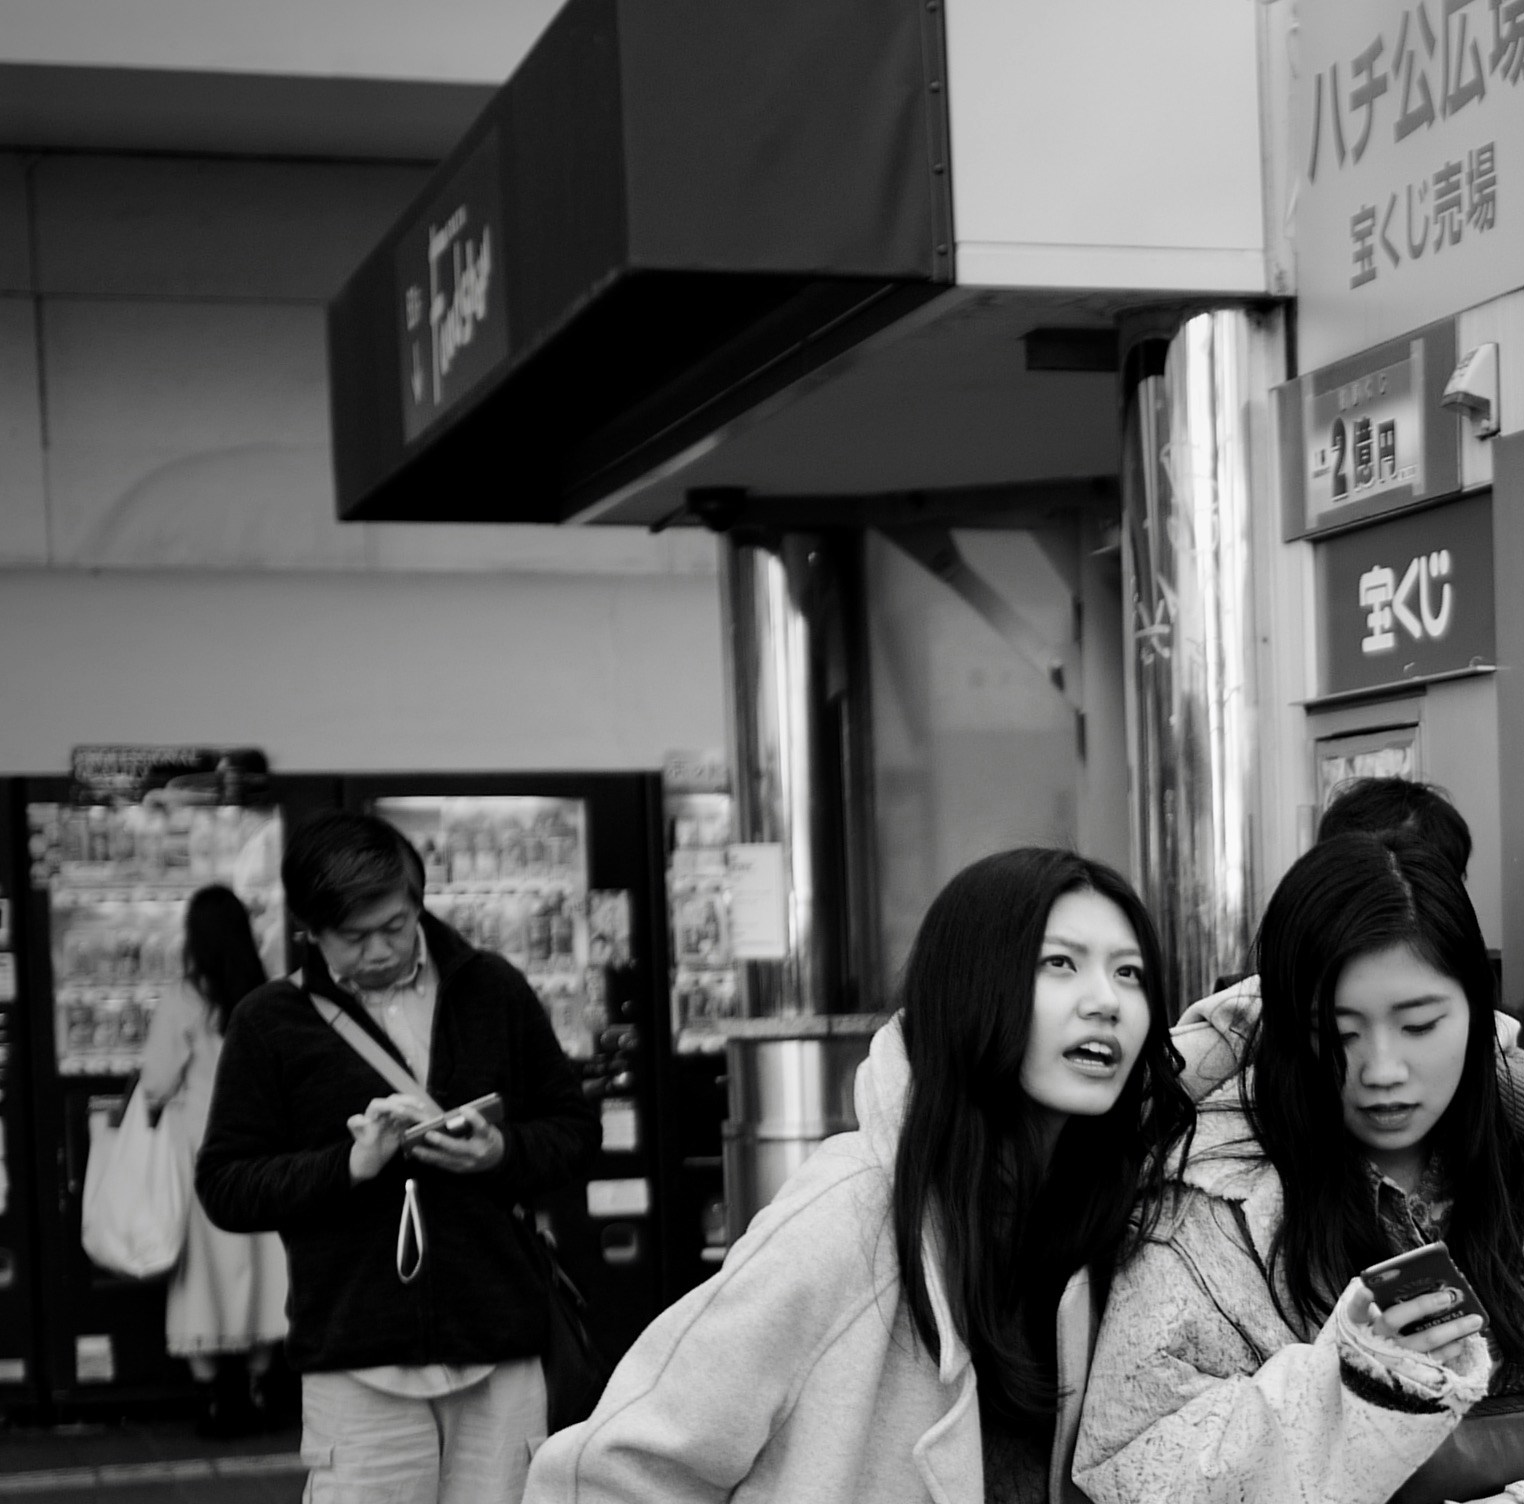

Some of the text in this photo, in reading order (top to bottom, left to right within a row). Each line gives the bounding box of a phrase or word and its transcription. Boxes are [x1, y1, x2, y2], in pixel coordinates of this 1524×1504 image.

[1350, 140, 1498, 290] 宝くじ売場
[1330, 415, 1398, 501] 2億円
[1358, 548, 1452, 654] 宝くじ
